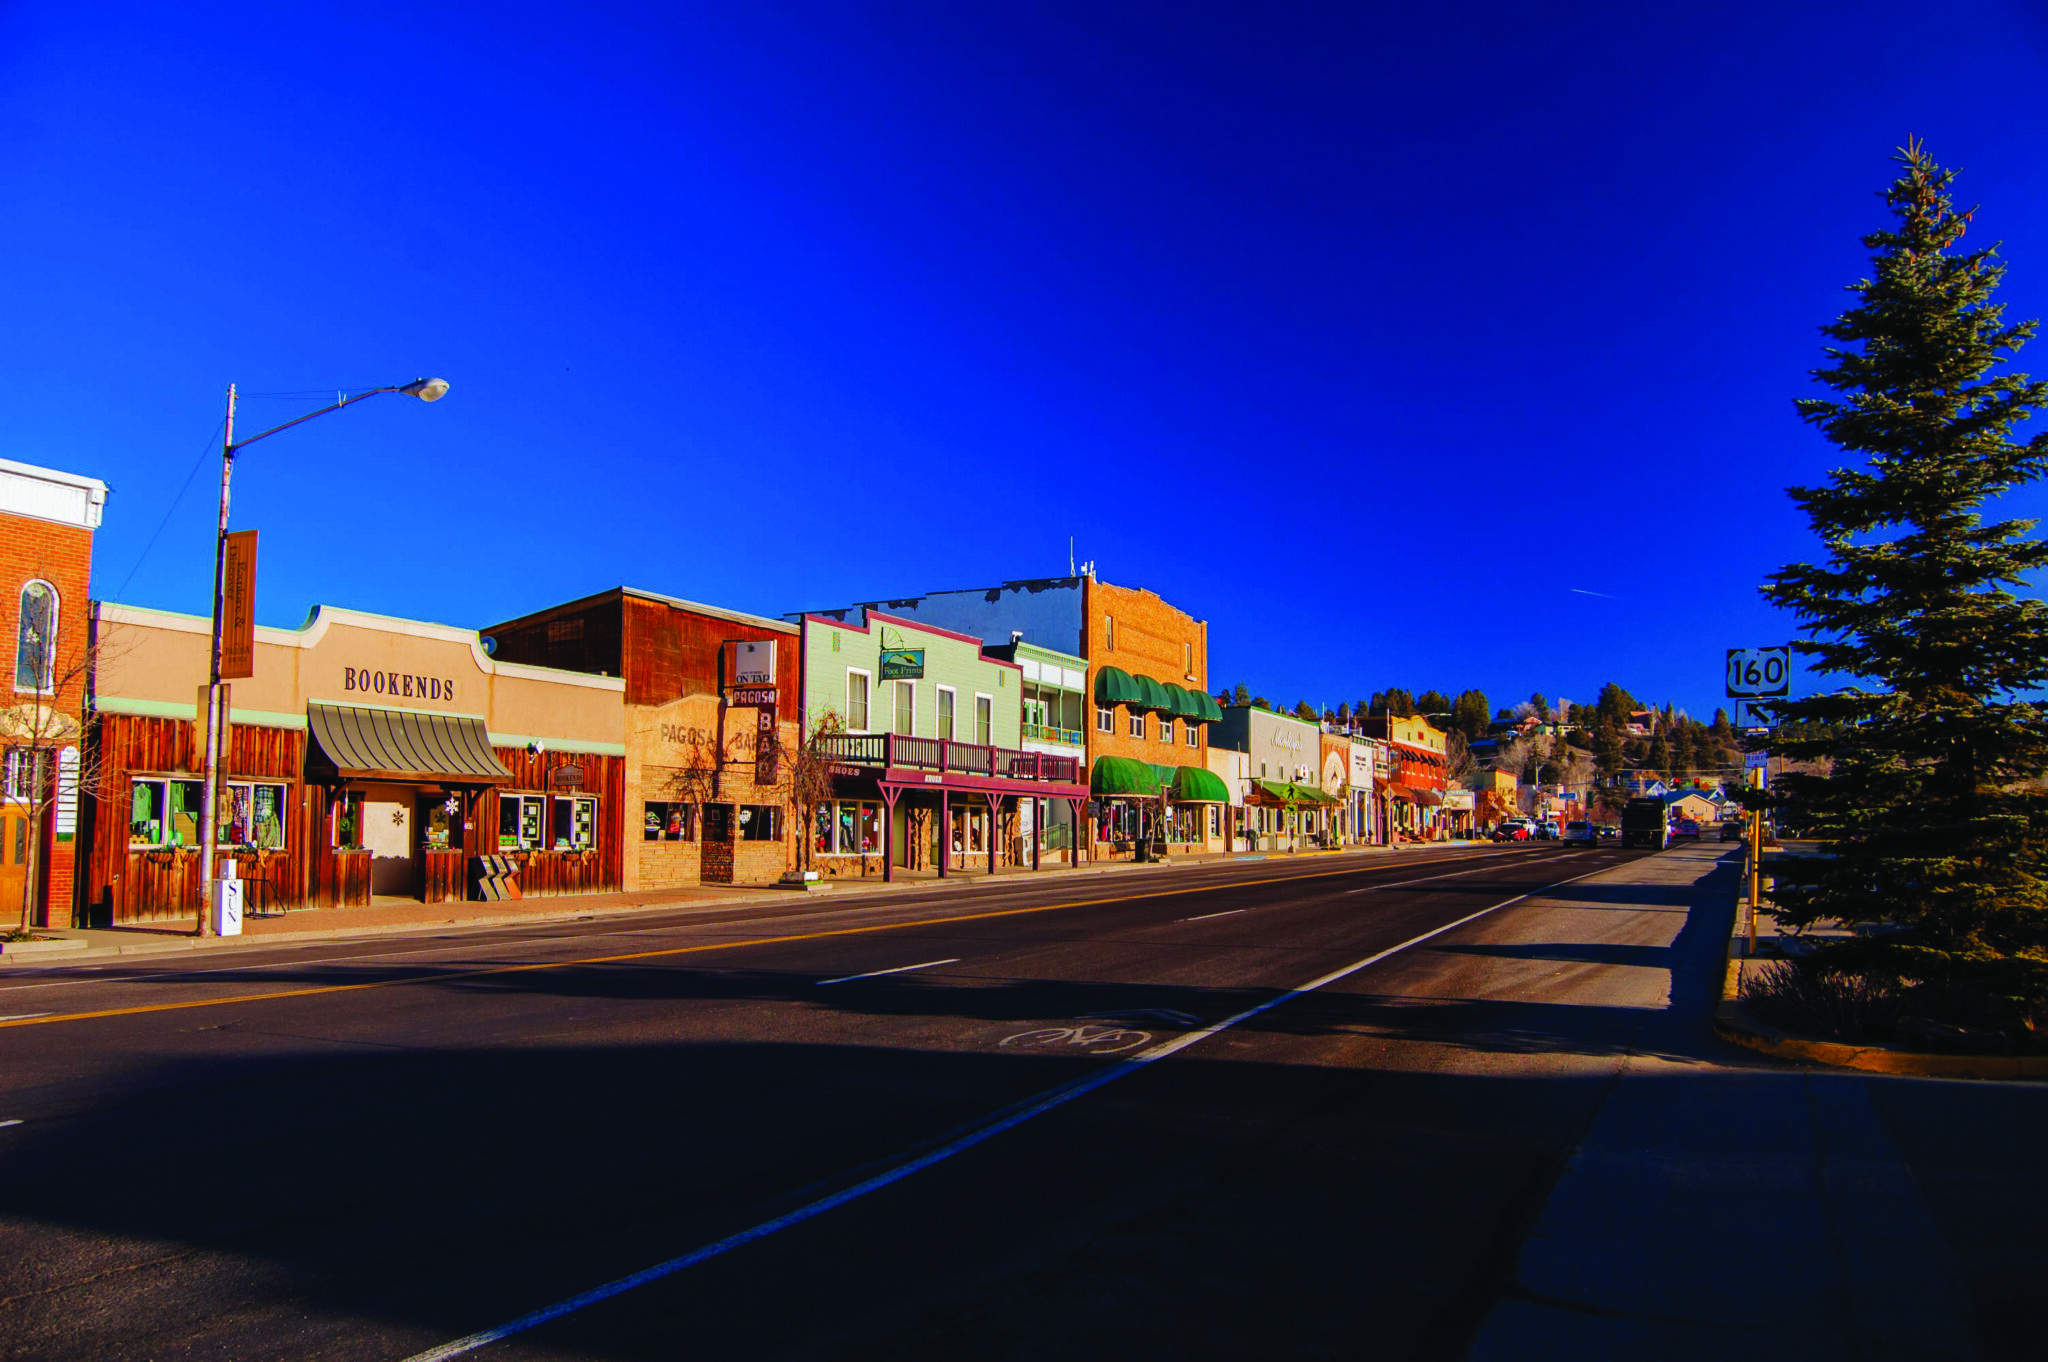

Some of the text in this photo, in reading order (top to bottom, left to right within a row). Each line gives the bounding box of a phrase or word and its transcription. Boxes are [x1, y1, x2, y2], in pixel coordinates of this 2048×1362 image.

[227, 545, 238, 600] Discover
[234, 561, 246, 628] Explore &
[344, 666, 454, 702] BOOKENDS
[736, 674, 771, 684] ON TAP
[884, 665, 923, 676] Foot Prints
[1733, 656, 1783, 686] 160
[733, 690, 776, 704] PAGOSA
[660, 722, 717, 747] PAGOSA
[828, 764, 860, 777] SHOES
[228, 880, 238, 924] SUN
